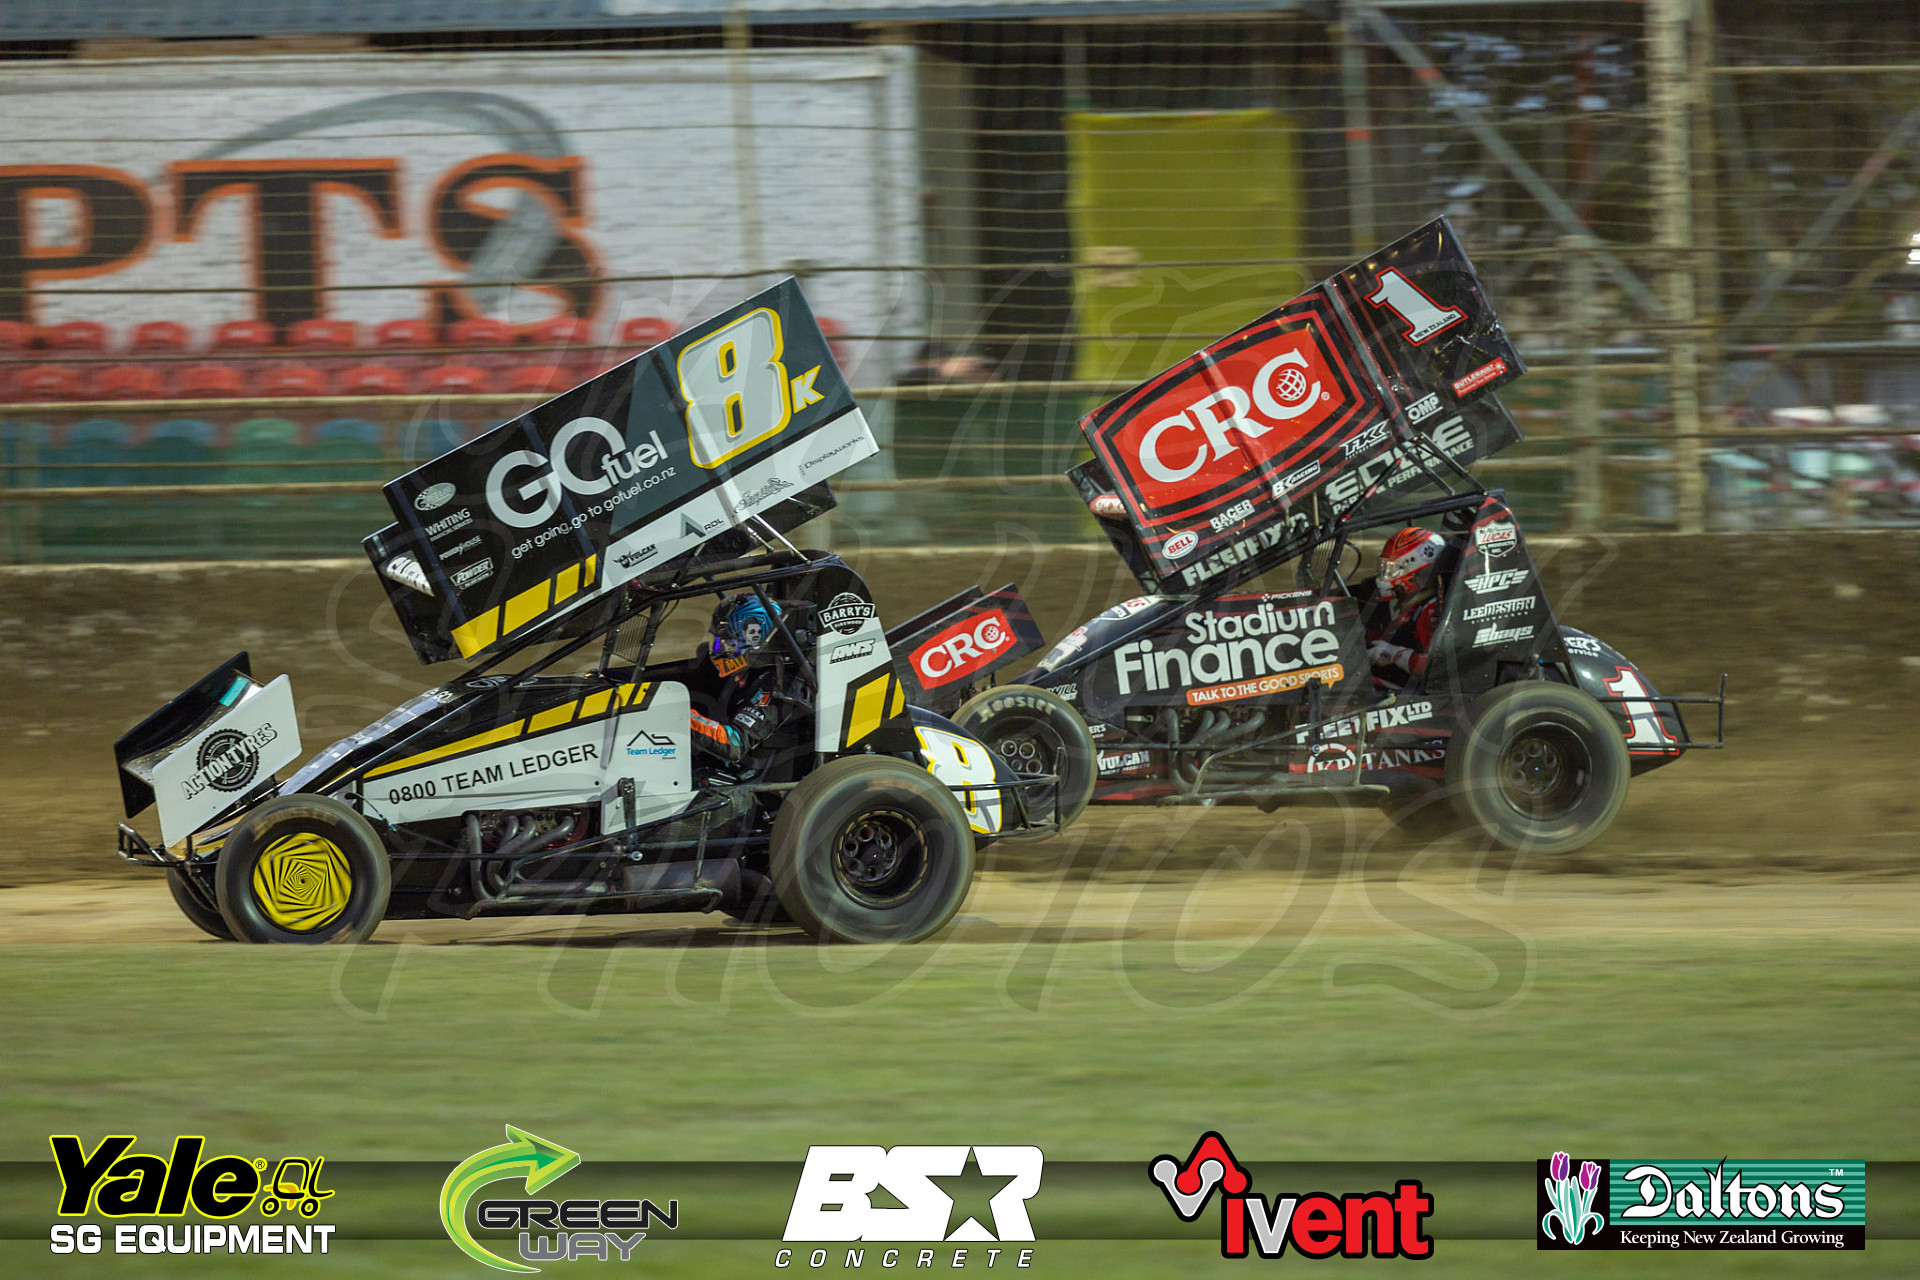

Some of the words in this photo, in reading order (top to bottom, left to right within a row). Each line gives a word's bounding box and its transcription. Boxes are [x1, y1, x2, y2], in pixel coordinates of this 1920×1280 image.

[1366, 267, 1467, 346] 1
[1414, 328, 1430, 339] NEW
[1429, 313, 1457, 332] ZEALAND
[1139, 347, 1321, 482] CRC
[1407, 397, 1440, 421] OMP
[804, 436, 865, 470] Displayworks
[1291, 461, 1319, 484] RACING
[424, 507, 471, 536] WHITING
[511, 538, 533, 560] get
[588, 504, 603, 518] to
[603, 466, 678, 511] gofuel.co.nz
[1209, 499, 1253, 530] RACER
[1167, 535, 1194, 555] BELL
[1480, 530, 1513, 544] LUCAS
[628, 543, 658, 563] VULCAN
[1270, 590, 1312, 600] PICKENS
[823, 604, 872, 622] BARRY'S
[1185, 601, 1335, 644] Stadium
[920, 616, 1006, 678] CRC
[1114, 628, 1339, 695] Finance
[1192, 689, 1220, 703] TALK
[1220, 686, 1237, 698] TO
[1237, 681, 1259, 695] THE
[1259, 675, 1298, 692] GOOD
[1294, 704, 1409, 744] FEETFIX
[1406, 701, 1433, 720] LTD
[1603, 666, 1681, 756] 1
[179, 752, 238, 801] ACTION
[231, 722, 278, 764] TYRES
[626, 747, 648, 756] Team
[649, 746, 677, 757] Ledger
[1096, 749, 1150, 771] VULCAN
[1361, 739, 1446, 771] TANKS
[389, 780, 437, 805] 0800
[441, 764, 504, 793] TEAM
[509, 743, 599, 778] LEDGER
[915, 726, 1002, 834] 8
